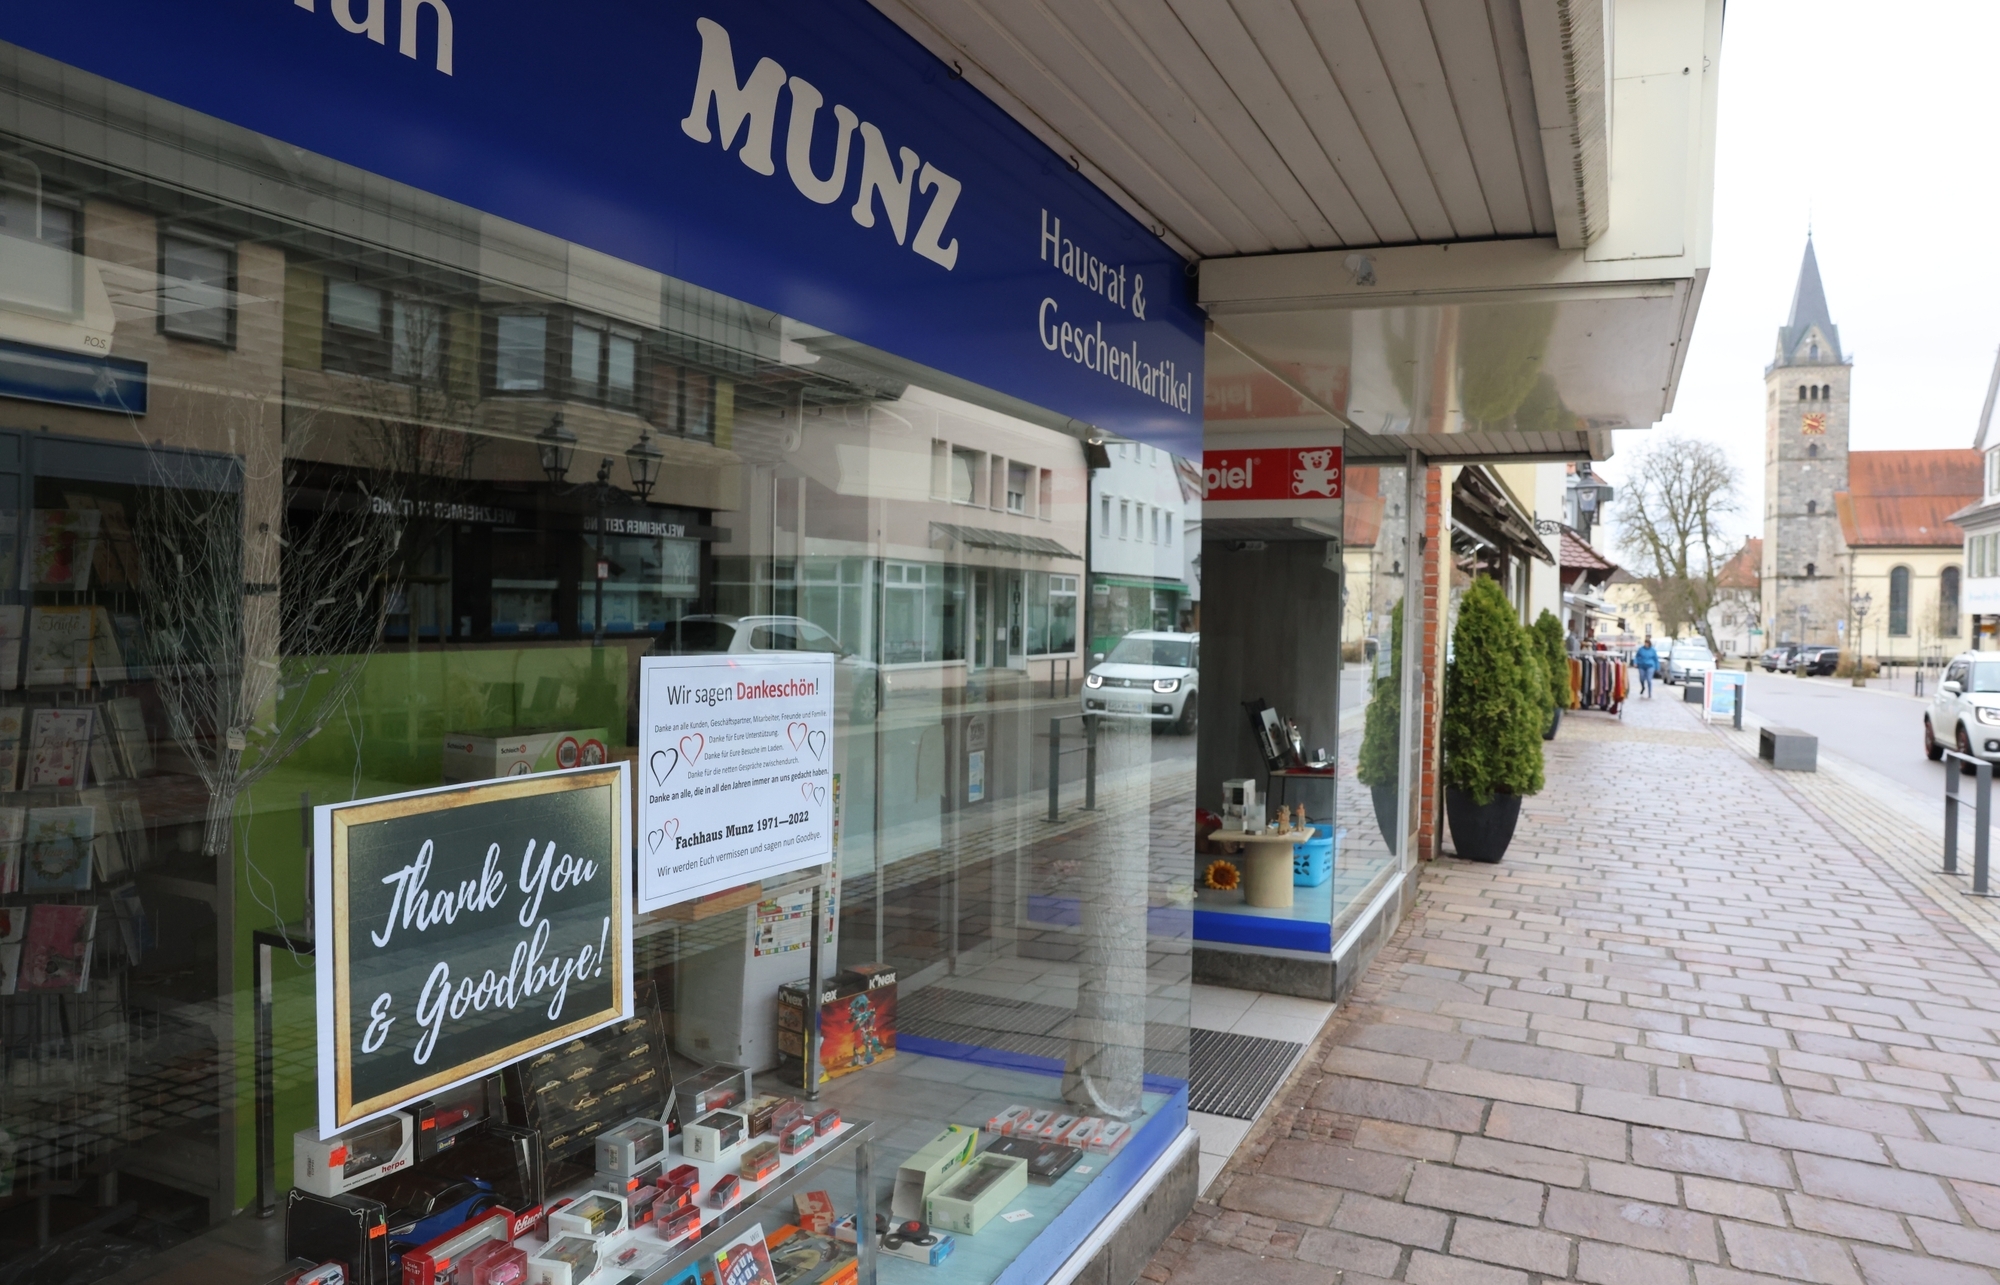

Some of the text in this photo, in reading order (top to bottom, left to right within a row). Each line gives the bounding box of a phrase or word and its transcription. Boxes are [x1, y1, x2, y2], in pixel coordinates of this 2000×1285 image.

[681, 17, 962, 271] MUNZ
[1041, 208, 1146, 321] Hausrat &
[1039, 297, 1192, 415] Geschenkartikel
[1202, 457, 1253, 499] piel
[667, 678, 819, 707] Wir sagen Dankeschön!
[655, 724, 671, 733] Danke
[680, 722, 689, 730] alle
[690, 720, 709, 729] Kunden,
[781, 712, 801, 720] Freunde
[709, 735, 725, 743] Danke
[688, 771, 703, 779] Danke
[713, 767, 721, 775] die
[722, 766, 738, 775] netten
[739, 762, 762, 772] Gespräche
[704, 752, 720, 760] Danke
[741, 747, 760, 755] Besuche
[649, 793, 670, 804] Danke
[680, 789, 693, 799] alle,
[694, 786, 703, 797] die
[705, 786, 711, 794] in
[720, 783, 731, 792] den
[732, 780, 751, 790] Jahren
[752, 777, 770, 786] immer
[780, 774, 790, 782] uns
[791, 771, 811, 782] gedacht
[812, 768, 829, 777] haben.
[657, 831, 821, 878] Wir werden Euch vermissen und sagen nun Goodbye.
[675, 829, 723, 850] Fachhaus
[725, 823, 754, 839] Munz
[371, 838, 598, 948] Thank You
[361, 917, 610, 1065] & Goodbye!
[382, 1159, 405, 1173] herpa
